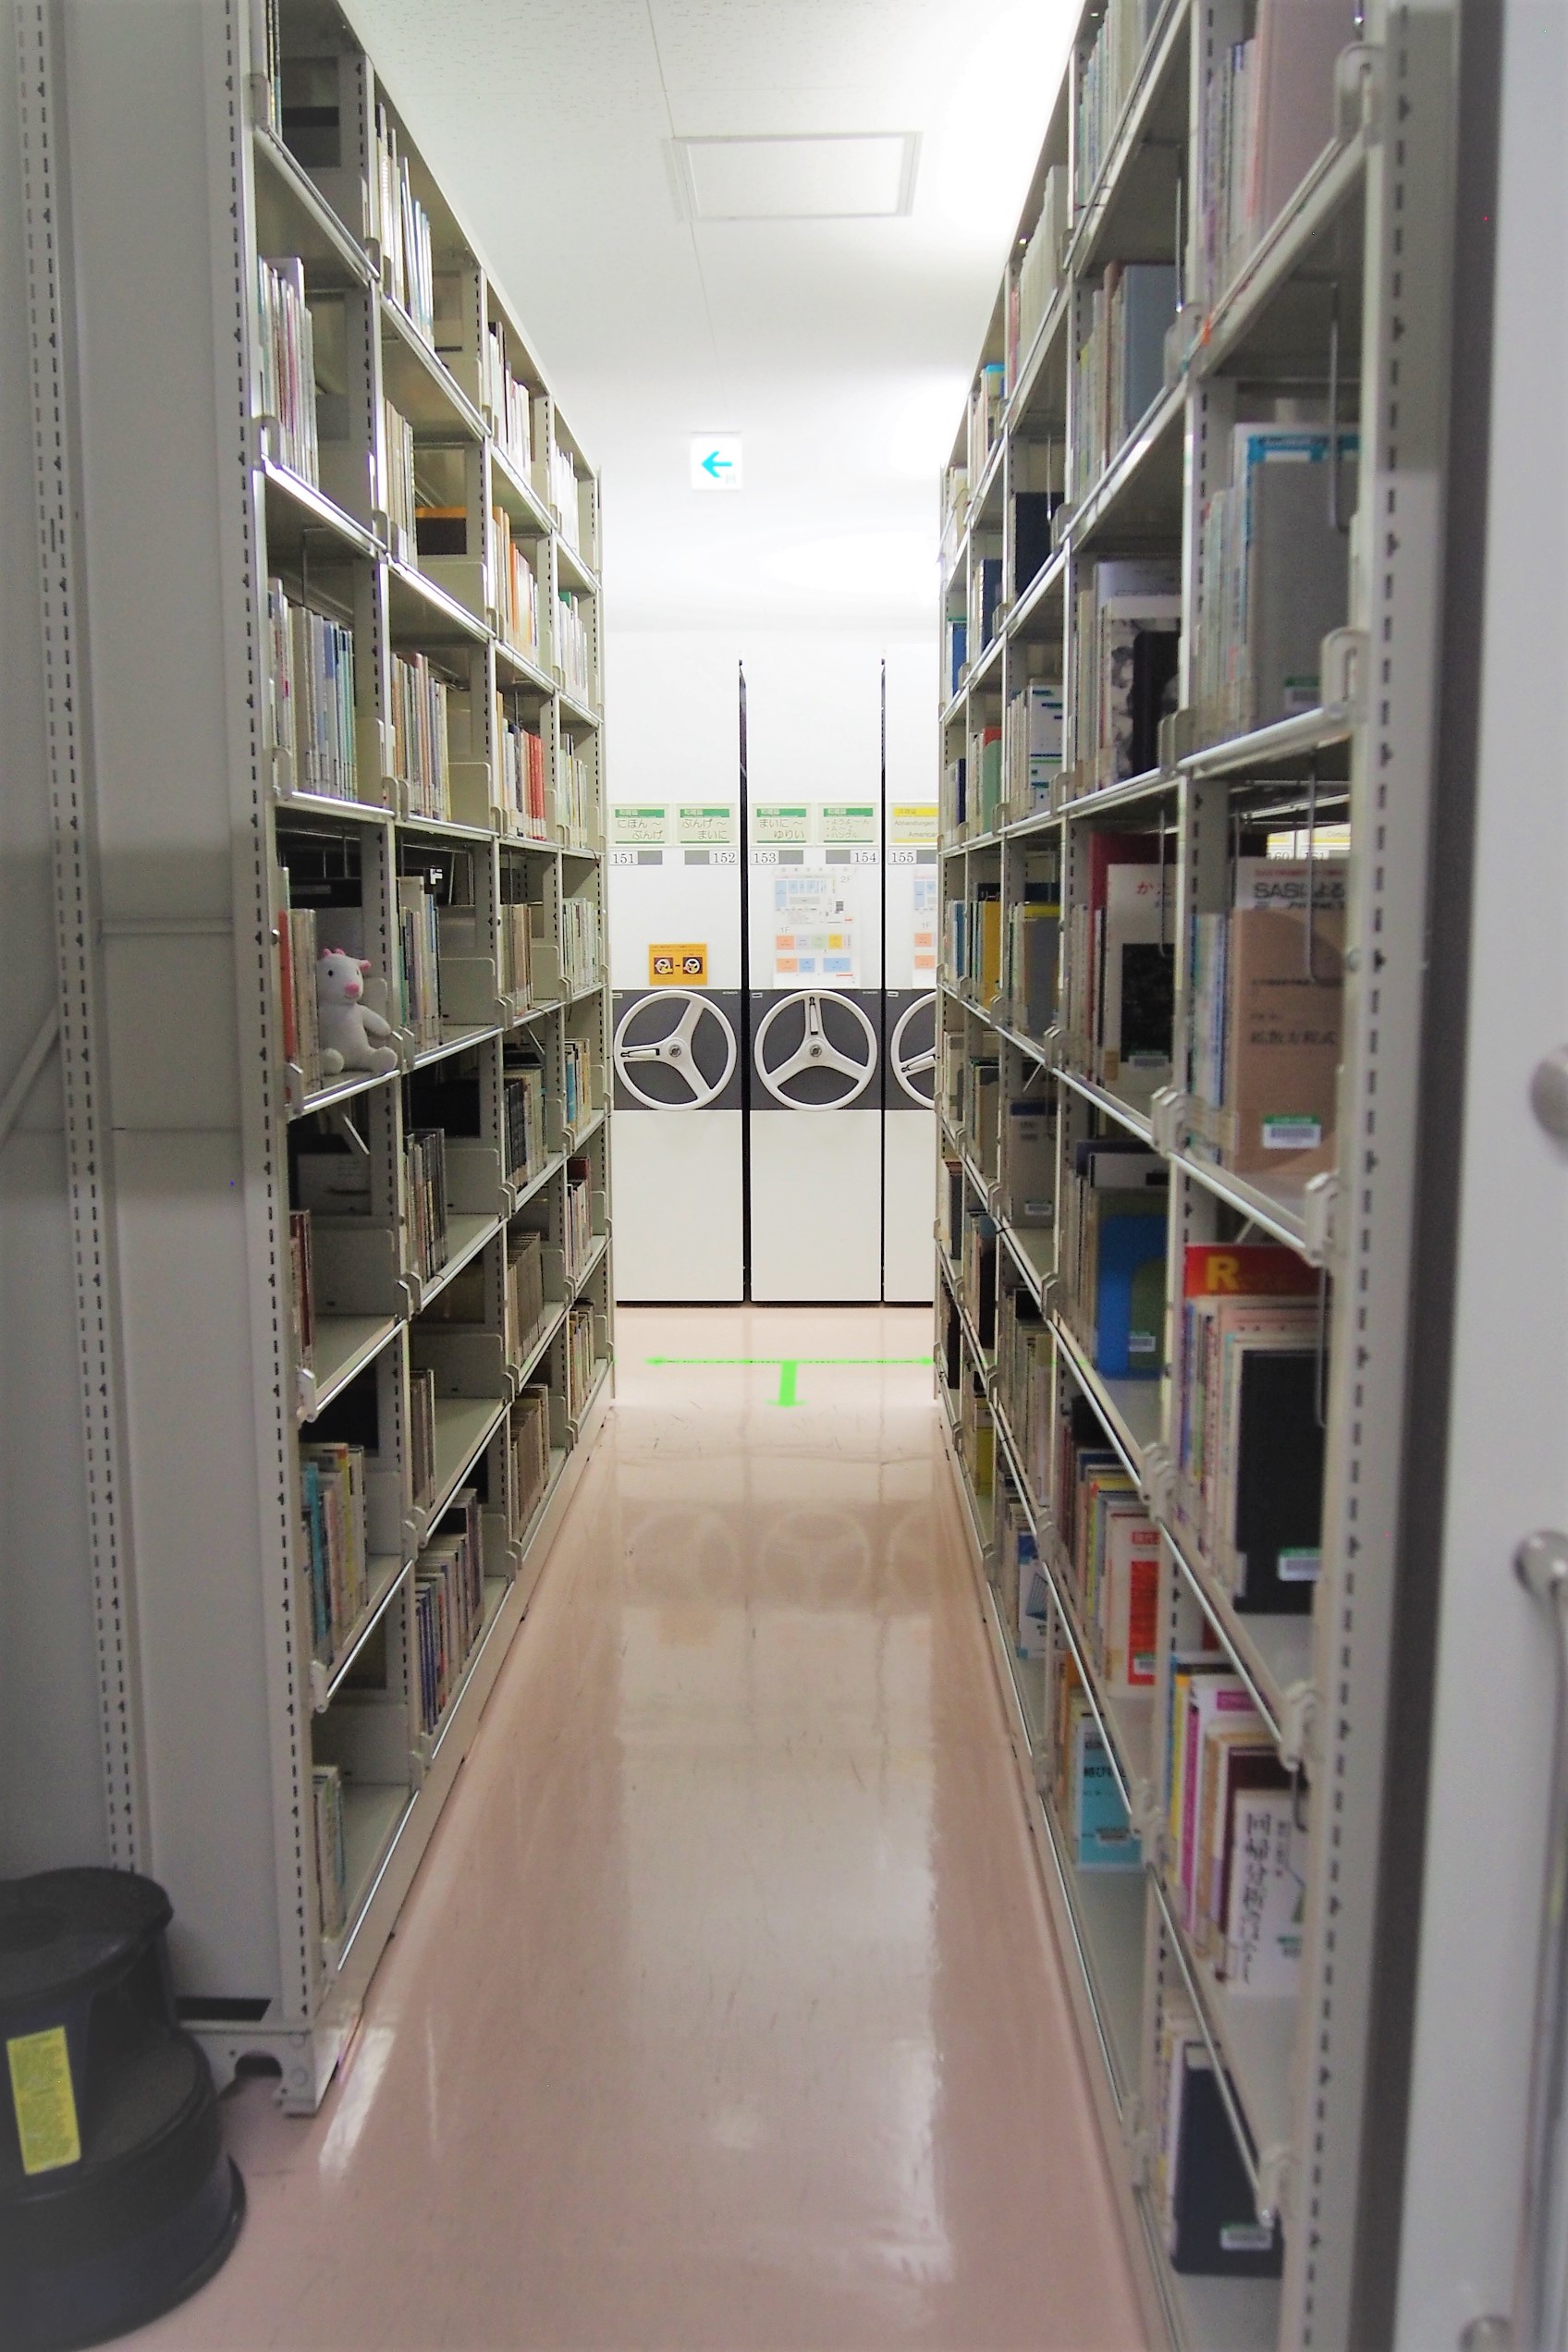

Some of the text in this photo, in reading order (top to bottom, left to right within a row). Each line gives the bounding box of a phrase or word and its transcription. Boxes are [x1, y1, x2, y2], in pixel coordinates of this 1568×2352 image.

[759, 818, 790, 827] まいに
[698, 830, 728, 839] まいに
[614, 853, 635, 864] 151
[714, 852, 736, 864] 152
[753, 852, 777, 864] 153
[854, 852, 876, 863] 154
[892, 852, 914, 863] 155
[1207, 1255, 1240, 1292] R
